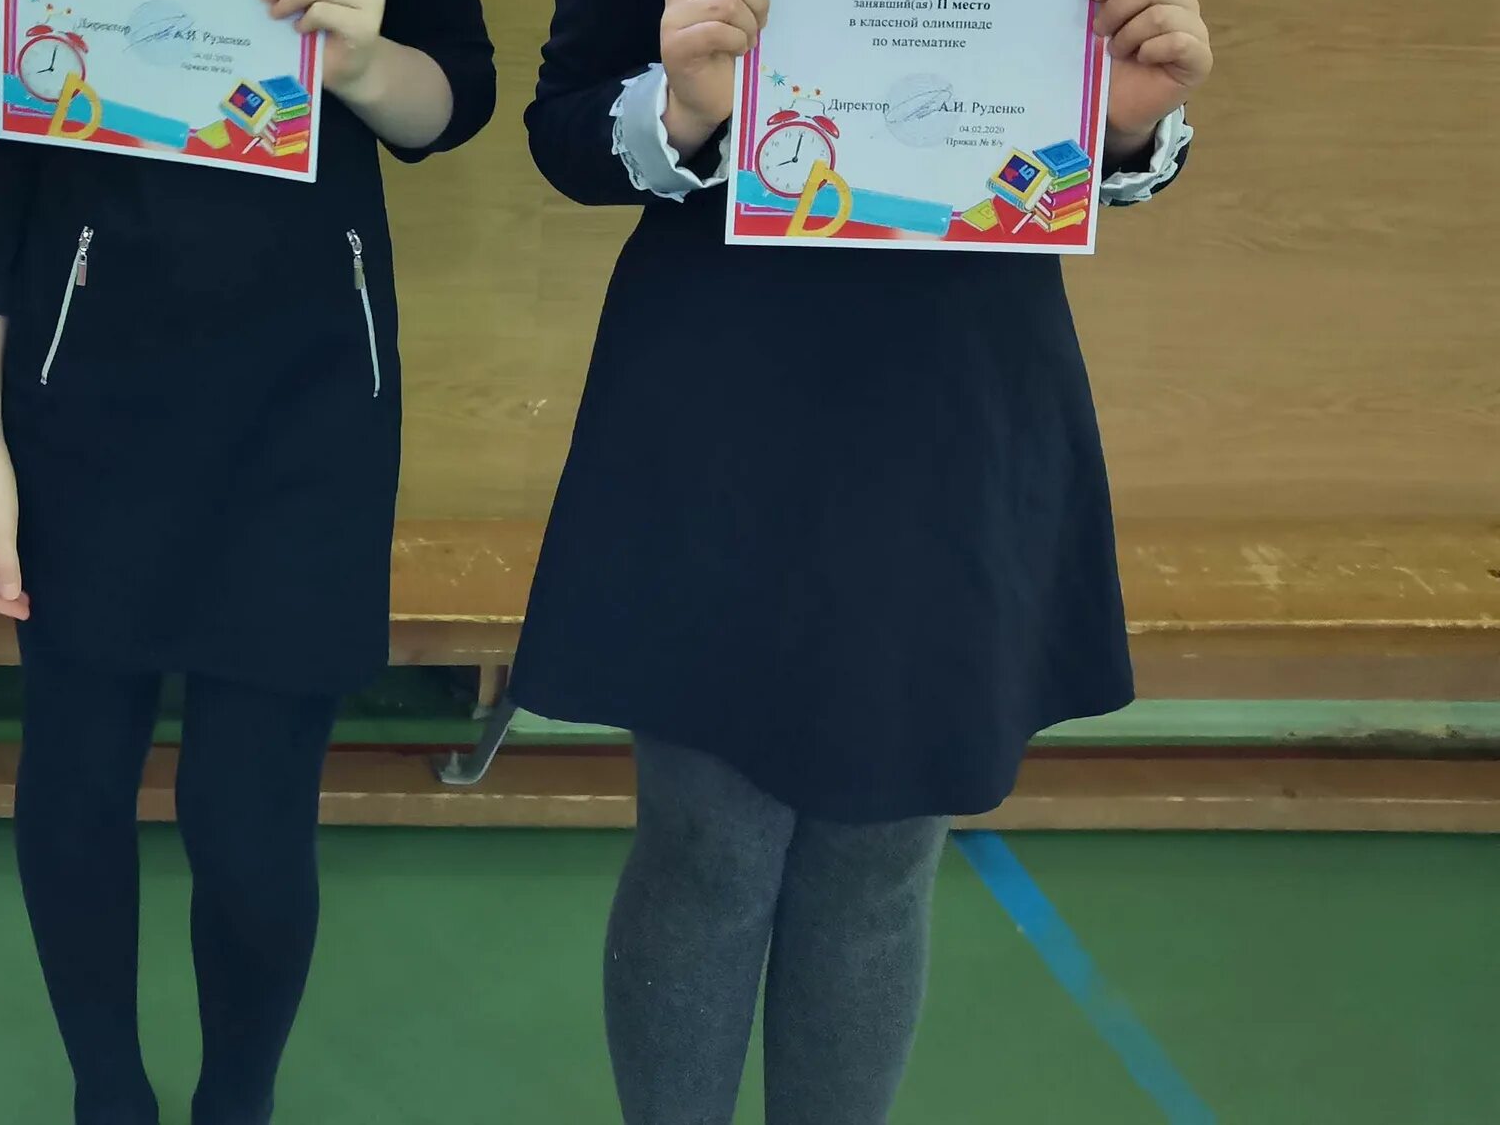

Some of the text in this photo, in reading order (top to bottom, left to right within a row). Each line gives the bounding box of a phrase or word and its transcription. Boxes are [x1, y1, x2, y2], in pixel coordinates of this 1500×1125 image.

[854, 0, 933, 10] занявший(ая)
[952, 1, 990, 10] место
[849, 17, 992, 29] в классной олимпиаде
[872, 37, 966, 48] по математике
[827, 98, 890, 114] Директор
[971, 101, 1025, 116] Руденко
